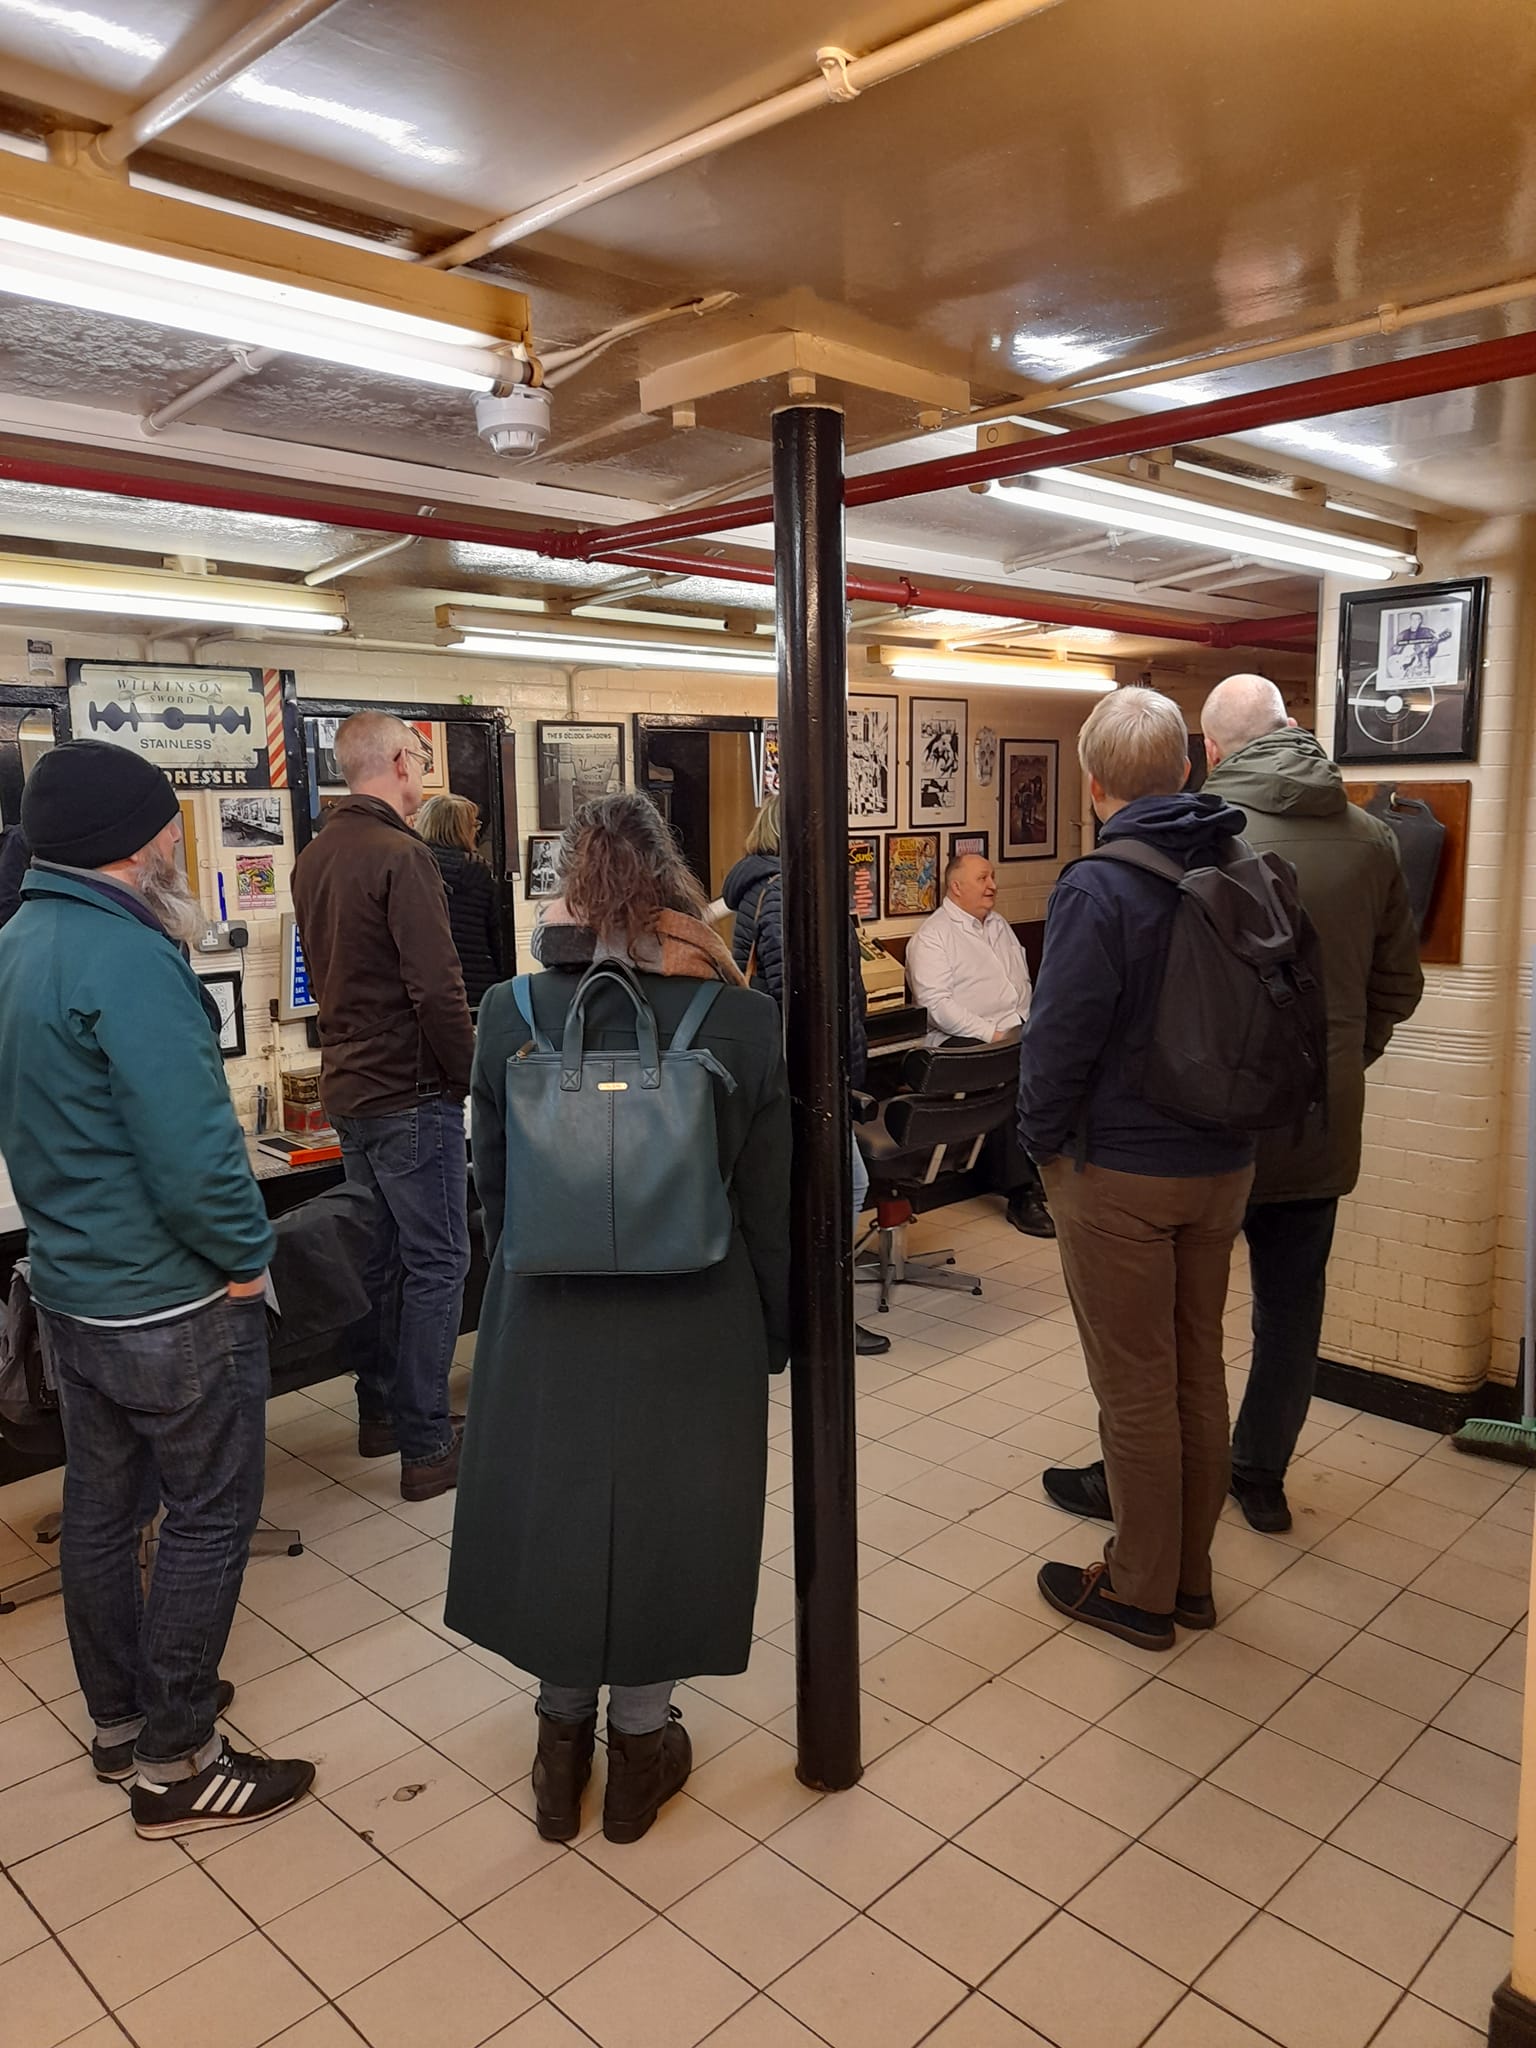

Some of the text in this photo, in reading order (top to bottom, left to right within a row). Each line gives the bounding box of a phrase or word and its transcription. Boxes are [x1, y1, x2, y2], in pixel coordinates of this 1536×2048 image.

[117, 679, 223, 693] WILKINSON
[150, 694, 194, 704] SWORD
[140, 738, 212, 750] STAINLESS
